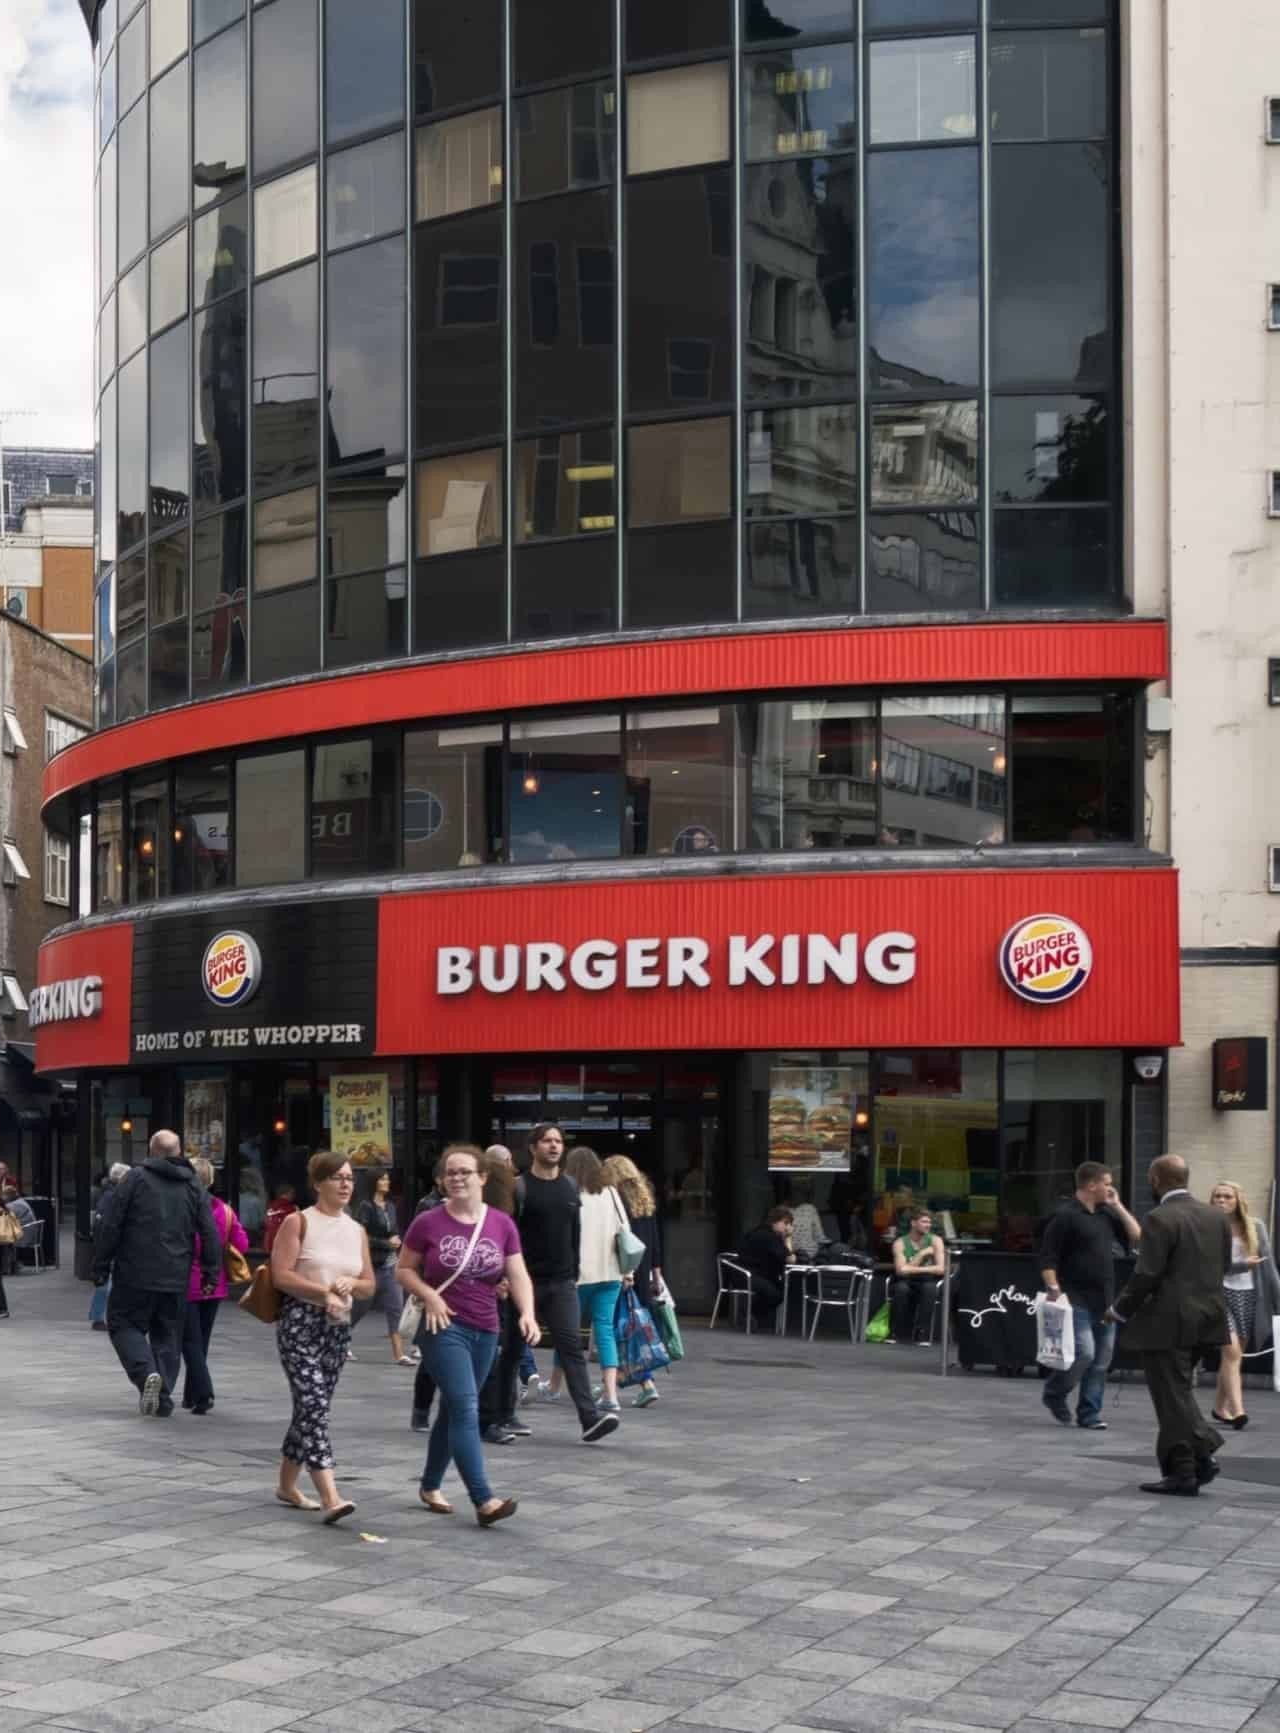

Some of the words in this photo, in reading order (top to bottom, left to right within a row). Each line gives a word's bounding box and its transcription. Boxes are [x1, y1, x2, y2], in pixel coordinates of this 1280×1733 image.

[207, 943, 245, 973] BURGER
[437, 937, 711, 996] BURGER
[728, 931, 916, 987] KING
[1013, 931, 1077, 962] BURGER
[209, 957, 247, 992] KING
[1016, 946, 1081, 986] KING
[49, 975, 102, 1022] KING
[135, 1032, 179, 1051] HOME
[183, 1030, 205, 1048] OF
[210, 1028, 249, 1047] THE
[254, 1023, 362, 1045] WHOPPER
